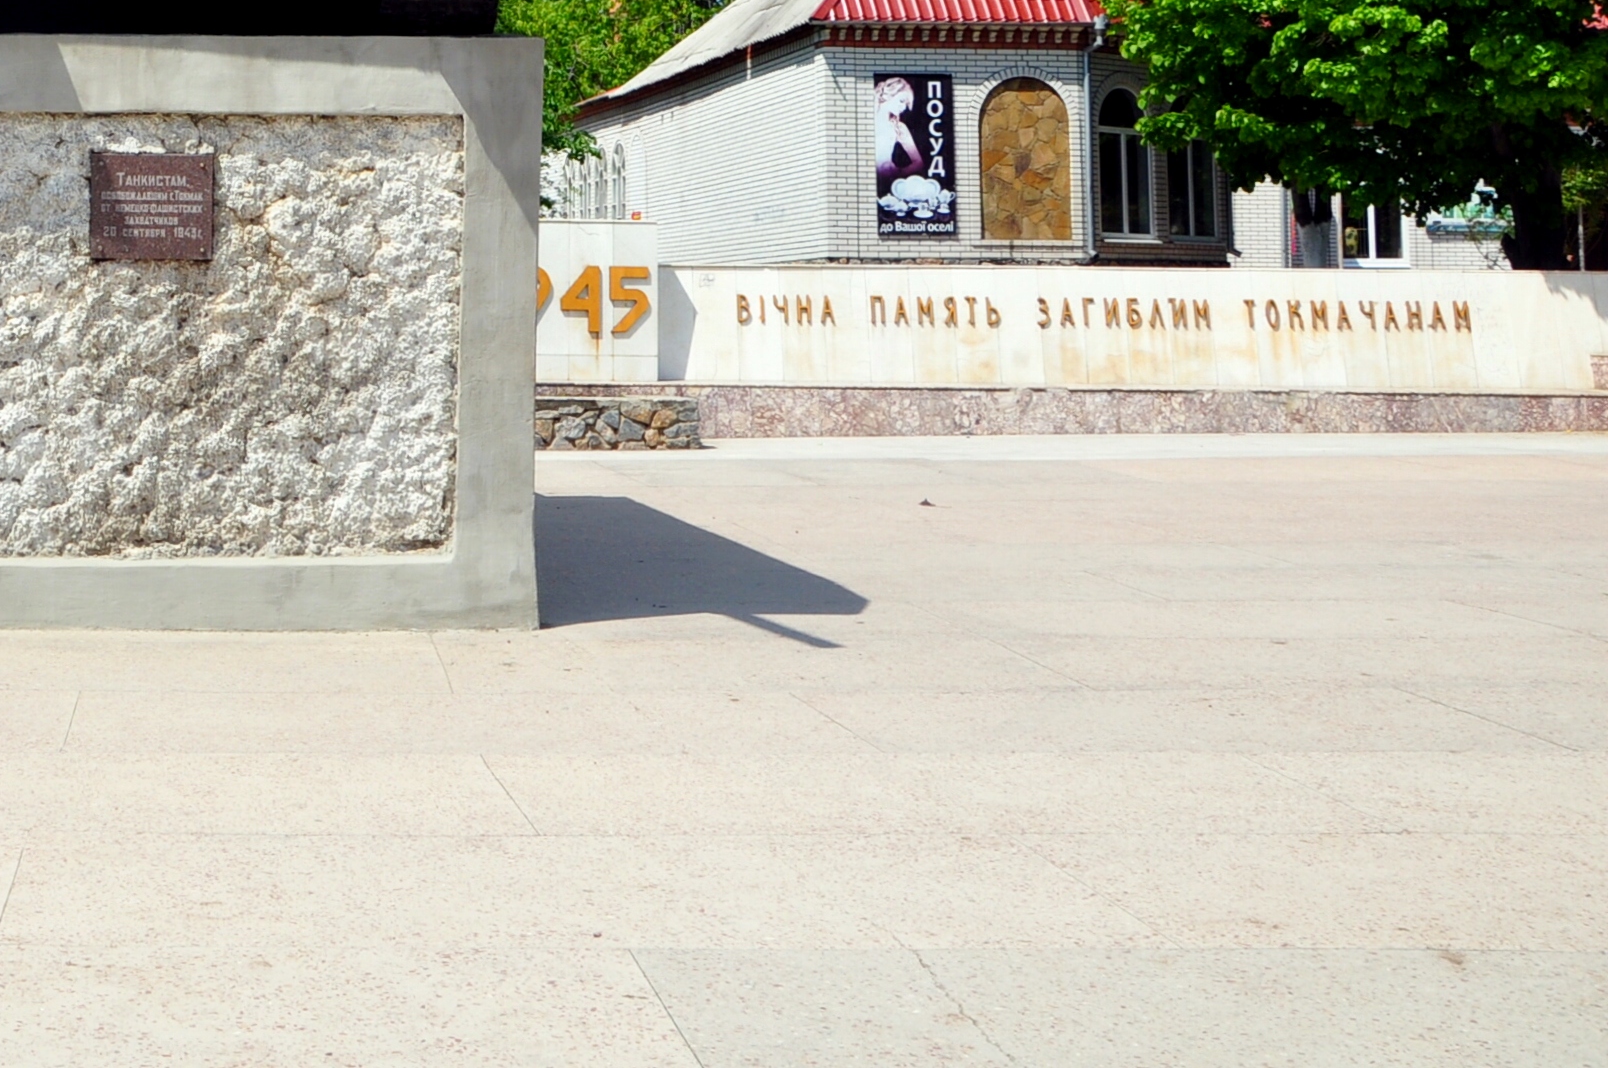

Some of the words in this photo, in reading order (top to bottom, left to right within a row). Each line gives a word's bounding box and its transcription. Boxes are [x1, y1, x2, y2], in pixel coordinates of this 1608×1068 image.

[926, 80, 946, 178] ПОСУД
[879, 223, 894, 233] до
[894, 220, 927, 232] Вашої
[927, 220, 954, 232] оселі
[736, 294, 836, 327] ВІЧНА
[869, 295, 1002, 329] ПАМЯТЬ
[1036, 296, 1212, 331] ЗАГИБЛИМ
[1243, 298, 1473, 333] ТОКМАЧАНАМ
